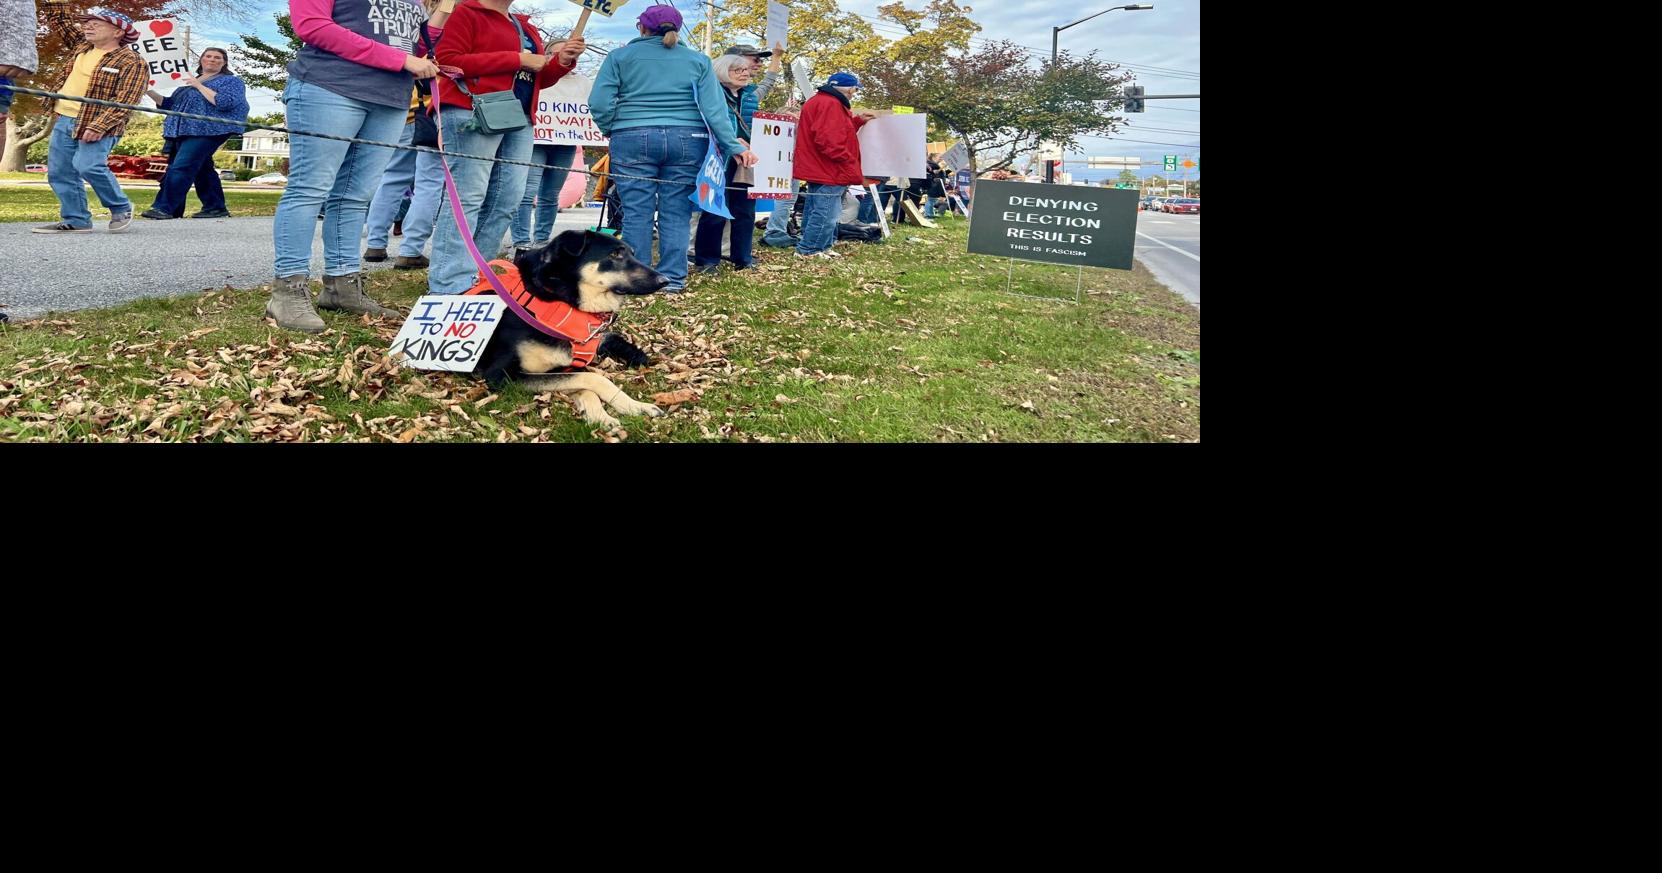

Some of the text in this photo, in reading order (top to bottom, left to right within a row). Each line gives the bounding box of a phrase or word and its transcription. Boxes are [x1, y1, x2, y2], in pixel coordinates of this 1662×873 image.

[368, 0, 424, 16] VETERA
[536, 115, 592, 130] NO WAY!
[763, 124, 781, 136] NO
[555, 130, 566, 140] in
[567, 129, 584, 141] the
[1009, 195, 1099, 212] DENYING
[1002, 211, 1101, 229] ELECTION
[1006, 227, 1093, 245] RESULTS
[1010, 243, 1029, 251] THIS
[1045, 247, 1087, 257] FASCISM
[413, 302, 496, 322] I HEEL
[420, 322, 477, 338] TO NO
[402, 338, 485, 363] KINGS!
